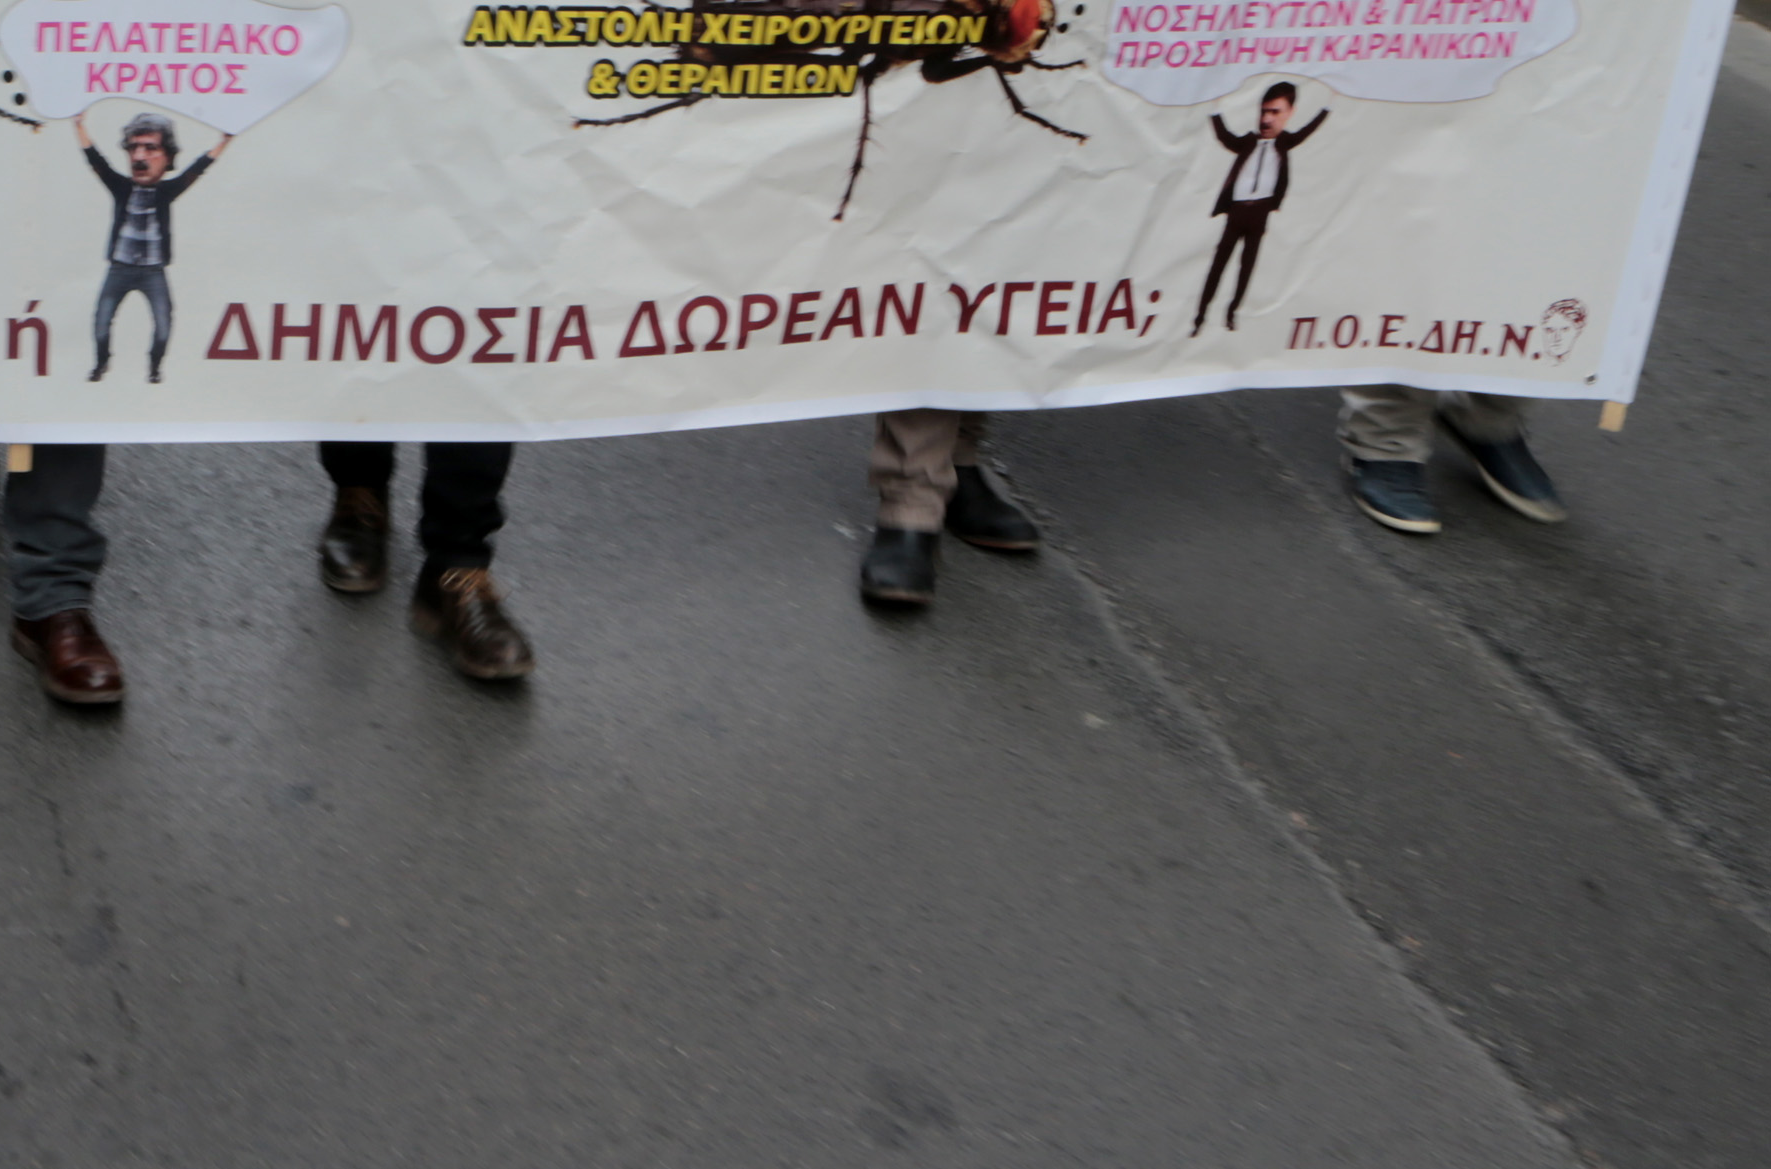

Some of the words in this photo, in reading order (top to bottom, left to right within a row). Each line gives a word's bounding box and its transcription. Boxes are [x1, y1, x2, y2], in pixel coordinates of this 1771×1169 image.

[466, 8, 694, 45] ΑΝΑΣΤΟΛΗ
[696, 12, 988, 46] ΧΕΙΡΟΥΡΓΕΙΩΝ
[1114, 0, 1359, 34] ΝΟΣΗΛΕΥΤΩΝ
[34, 20, 302, 56] ΠΕΛΑΤΕΙΑΚΟ
[1114, 36, 1316, 69] ΠΡΟΣΛΗΨΗ
[1318, 32, 1518, 62] ΚΑΡΑΝΙΚΩΝ
[84, 62, 246, 95] ΚΡΑΤΟΣ
[585, 60, 623, 96] &
[626, 62, 859, 96] ΘΕΡΑΠΕΙΩΝ
[4, 299, 52, 377] ή
[203, 302, 597, 365] ΔΗΜΟΣΙΑ
[617, 281, 928, 359] ΔΩΡΕΑΝ
[944, 277, 1164, 339] ΥΓΕΙΑ;
